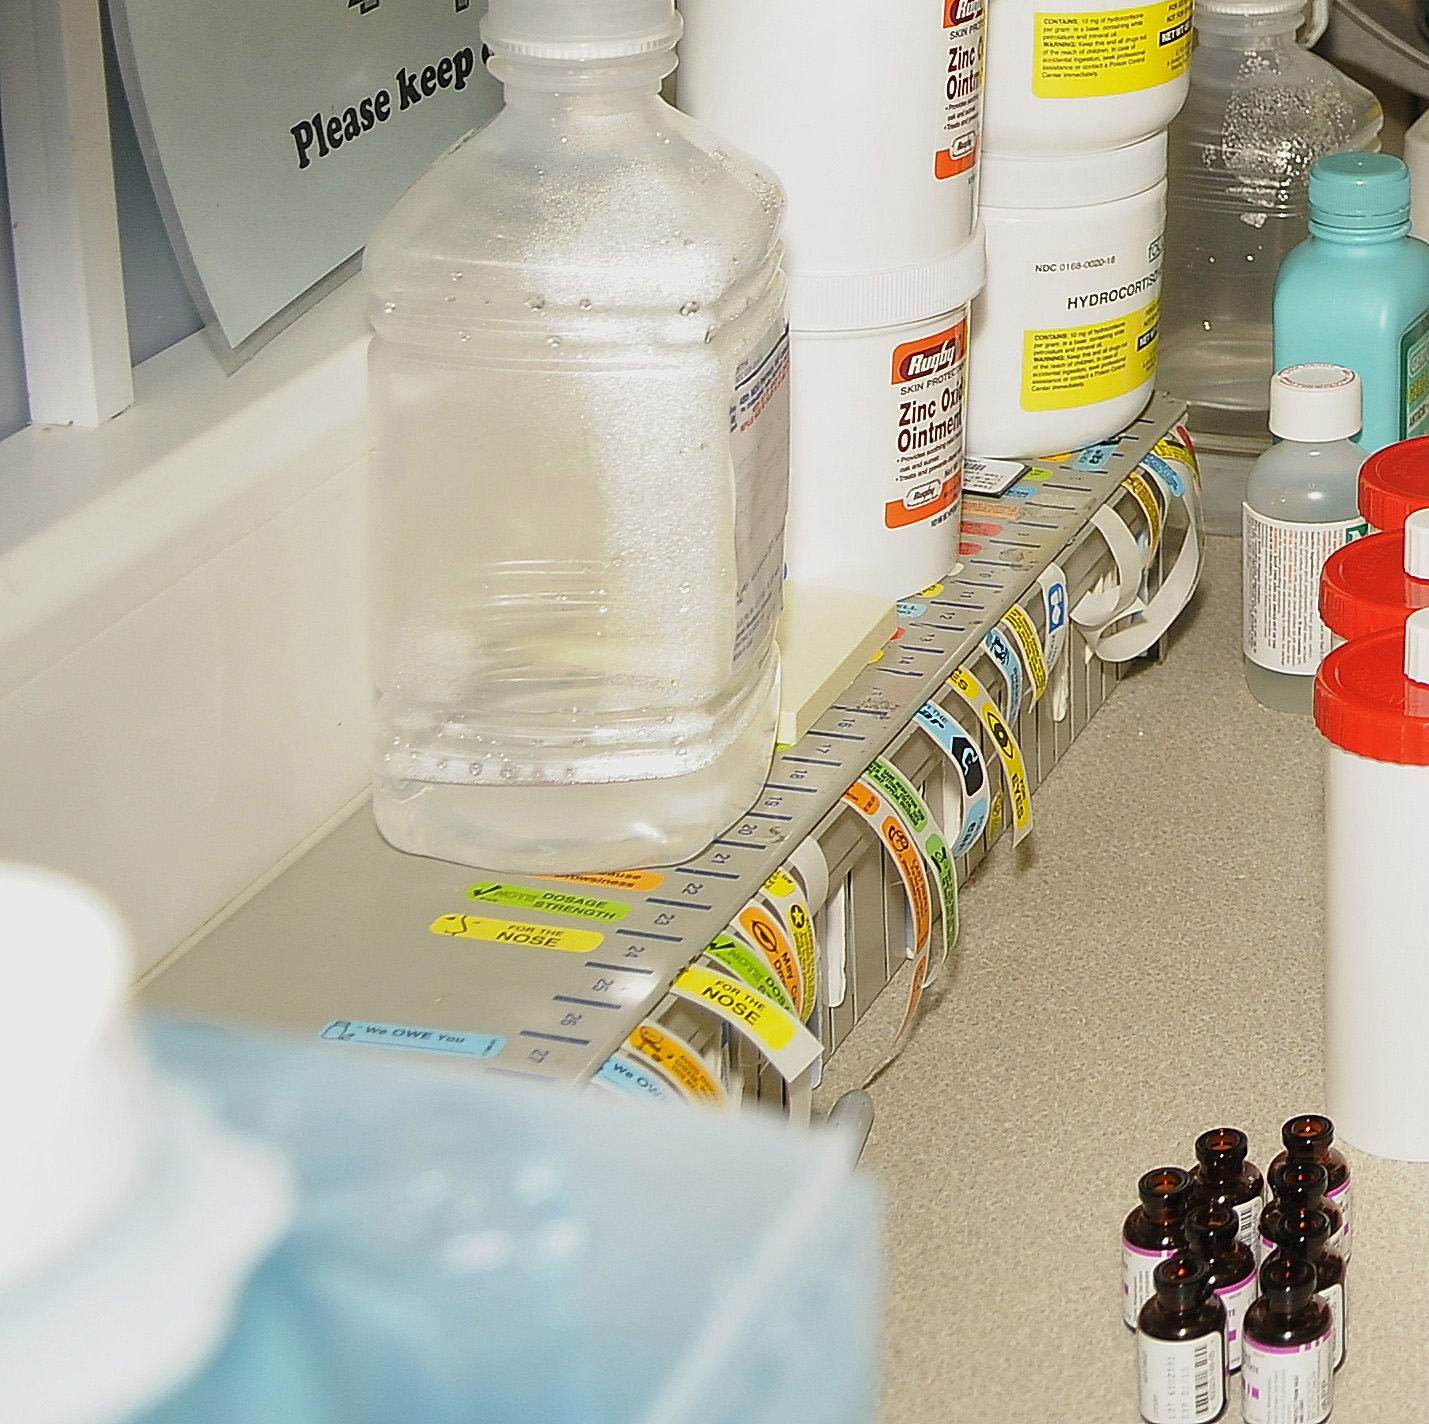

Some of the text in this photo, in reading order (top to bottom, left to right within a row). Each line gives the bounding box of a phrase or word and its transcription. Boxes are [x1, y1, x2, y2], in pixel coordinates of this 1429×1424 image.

[948, 46, 975, 73] Zinc
[291, 47, 474, 168] Please keep
[1035, 264, 1057, 272] NDC
[908, 340, 955, 375] Rugby
[901, 383, 924, 395] SKIN
[898, 400, 936, 427] Zinc
[738, 824, 758, 836] 20
[711, 852, 730, 865] 21
[682, 882, 703, 897] 22
[542, 892, 607, 908] DOSAGE
[533, 901, 616, 920] STRENGTH
[654, 913, 675, 927] 23
[508, 924, 537, 932] FOR
[496, 932, 561, 947] NOSE
[625, 945, 645, 959] 24
[782, 952, 793, 979] May
[592, 977, 614, 992] 25
[715, 980, 766, 1011] FOR THE
[702, 987, 761, 1025] NOSE
[561, 1012, 582, 1027] 26
[365, 1026, 465, 1043] We OWE You
[614, 1063, 665, 1101] We OW
